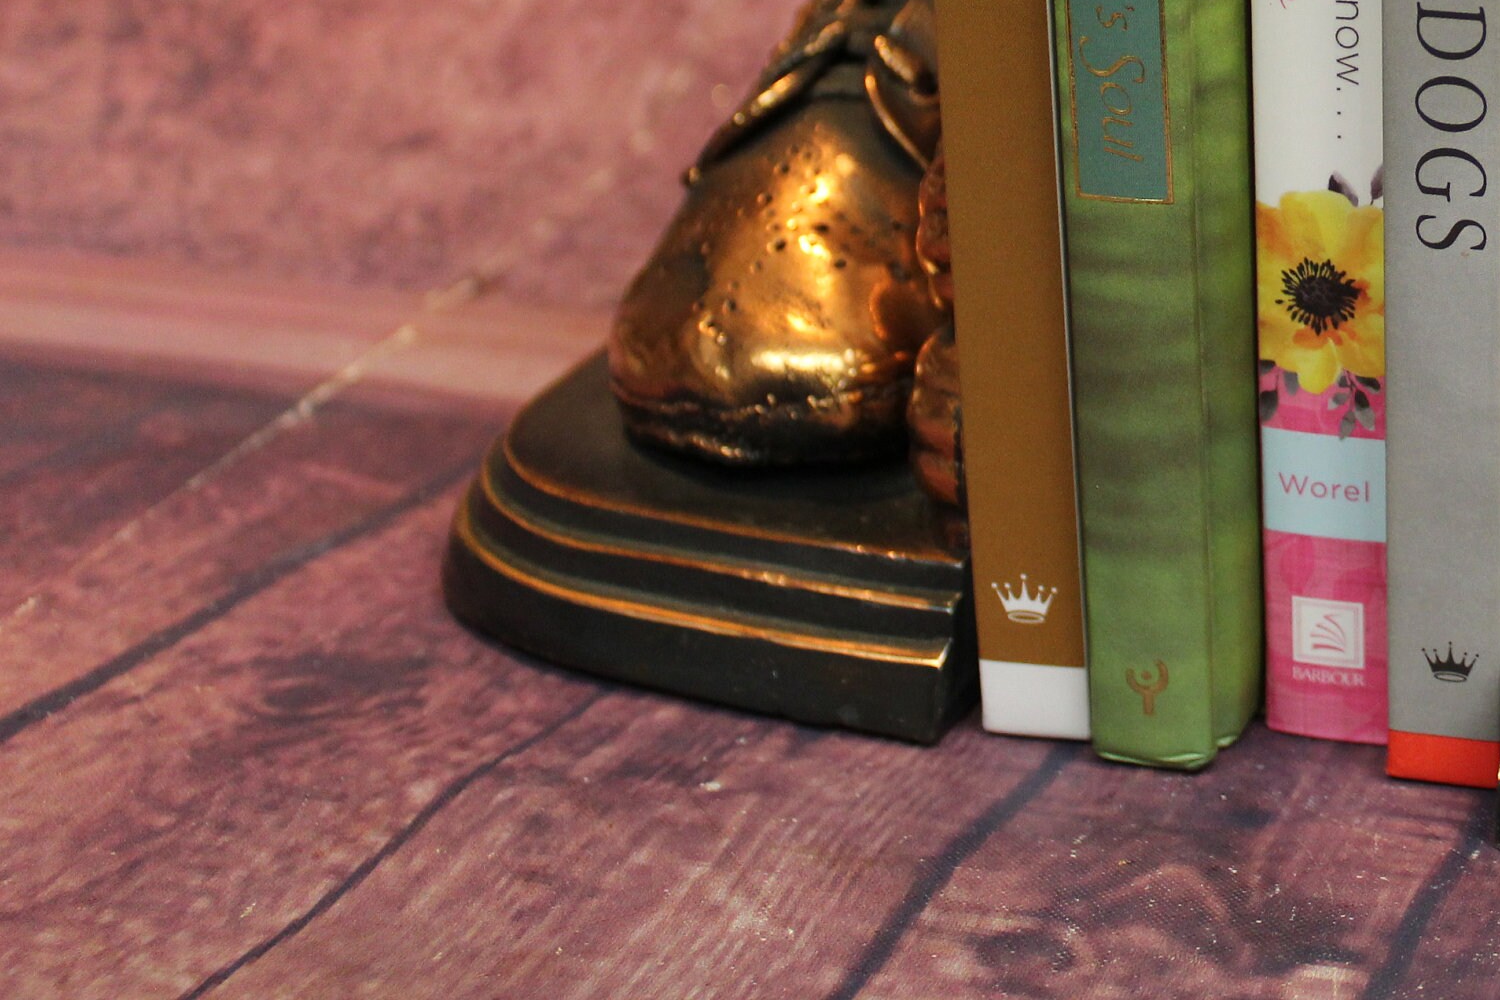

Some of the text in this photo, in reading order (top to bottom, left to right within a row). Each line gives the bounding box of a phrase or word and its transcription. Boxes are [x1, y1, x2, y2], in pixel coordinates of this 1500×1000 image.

[1079, 36, 1146, 163] Soul
[1278, 471, 1371, 502] Worel
[1292, 664, 1365, 687] BARBOUR
